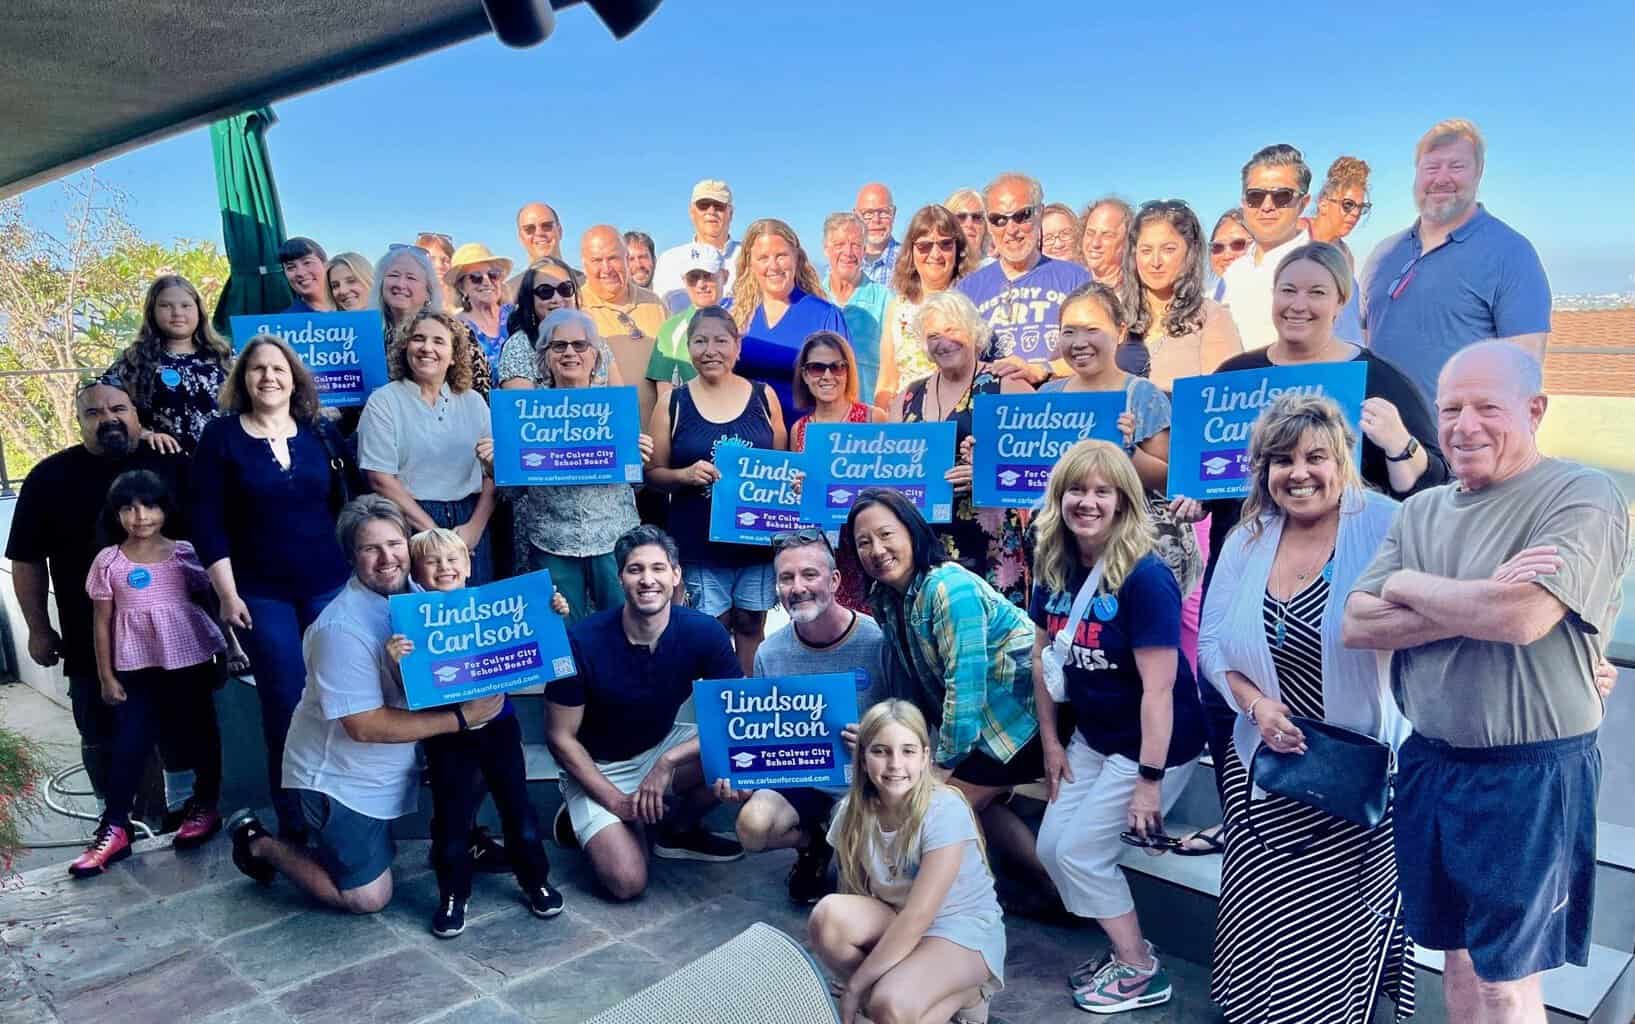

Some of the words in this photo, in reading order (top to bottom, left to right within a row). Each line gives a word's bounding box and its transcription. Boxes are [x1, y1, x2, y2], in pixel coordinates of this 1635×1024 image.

[988, 300, 1051, 327] ART
[515, 395, 613, 426] Lindsay
[996, 401, 1096, 439] Lindsay
[521, 419, 614, 442] Carlson
[550, 452, 565, 460] For
[566, 451, 594, 459] Culver
[596, 450, 614, 458] City
[829, 431, 928, 463] Lindsay
[554, 459, 582, 467] School
[584, 458, 609, 466] Board
[738, 457, 801, 481] Linds
[830, 455, 926, 479] Carlson
[1024, 470, 1039, 478] For
[739, 481, 801, 505] Carls
[763, 512, 776, 521] For
[766, 521, 792, 529] School
[419, 594, 528, 628] Lindsay
[427, 620, 534, 655] Carlson
[464, 661, 481, 670] For
[482, 654, 515, 666] Culver
[516, 648, 537, 658] City
[470, 663, 503, 677] School
[504, 657, 533, 671] Board
[720, 685, 828, 720] Lindsay
[728, 713, 829, 740] Carlson
[760, 750, 776, 759] For
[778, 749, 810, 758] Culver
[811, 748, 831, 758] City
[765, 758, 796, 767] School
[798, 757, 826, 766] Board
